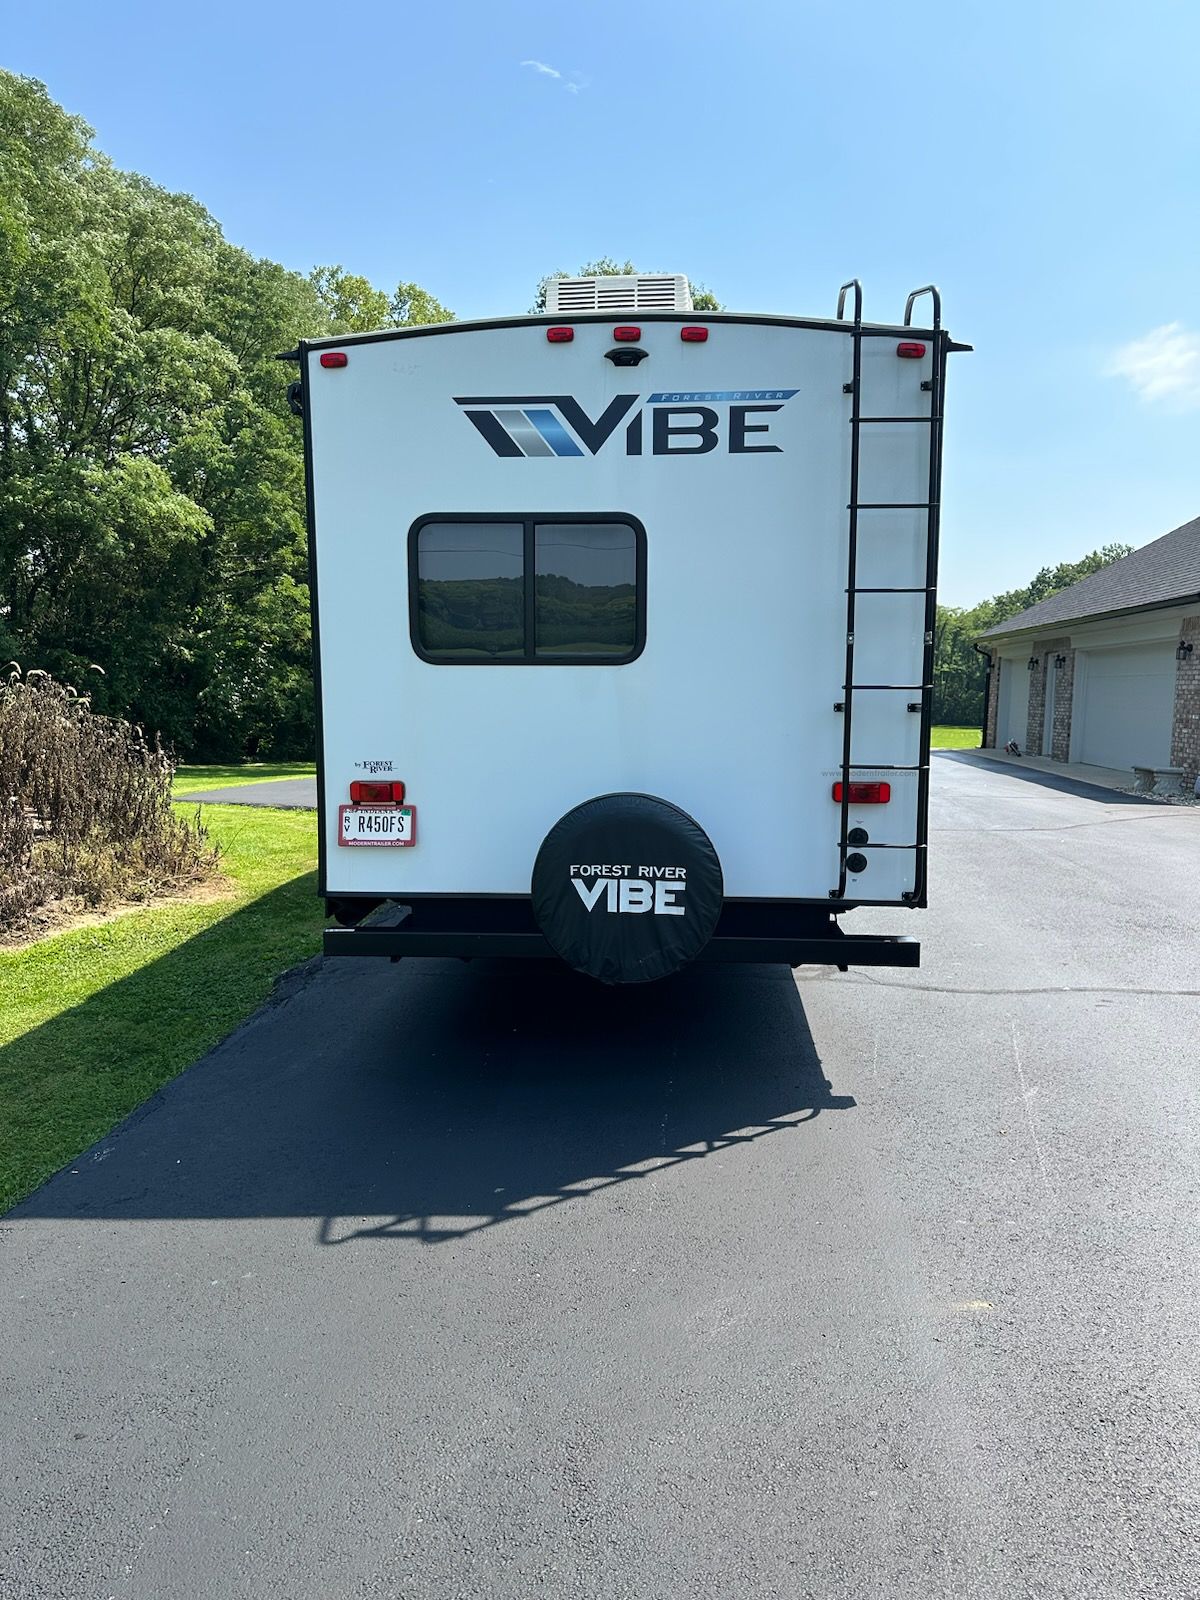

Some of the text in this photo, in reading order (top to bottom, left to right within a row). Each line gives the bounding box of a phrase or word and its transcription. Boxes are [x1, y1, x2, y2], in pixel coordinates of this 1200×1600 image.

[733, 392, 784, 400] RIVER
[452, 393, 785, 456] VIBE
[363, 760, 393, 769] FOREST
[822, 769, 917, 777] www.oderntrailer.com
[358, 815, 404, 833] R450FS
[570, 864, 687, 879] FOREST RIVER
[570, 878, 687, 916] VIBE
